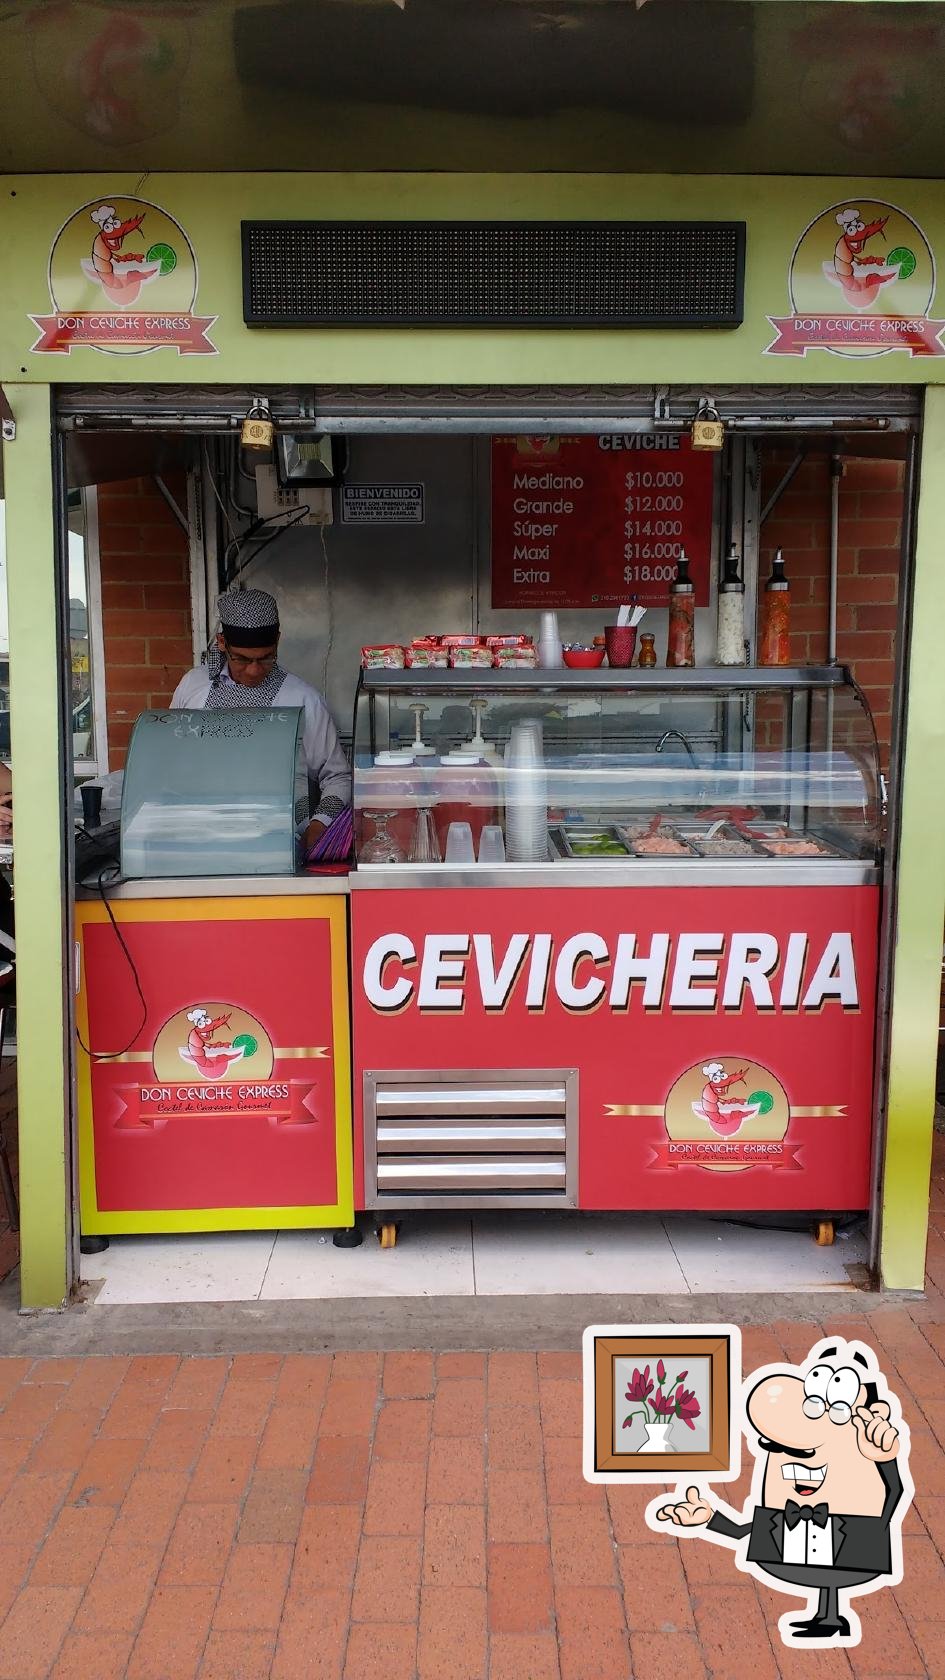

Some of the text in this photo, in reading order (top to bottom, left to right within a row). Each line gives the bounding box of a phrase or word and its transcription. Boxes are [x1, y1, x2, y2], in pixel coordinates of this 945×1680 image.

[57, 317, 191, 330] DON CEVICHE EXPRESS
[794, 320, 925, 333] DON CEVICHE EXPRESS
[598, 434, 680, 450] CEVICHE
[513, 471, 684, 490] Mediano $10.000
[346, 488, 419, 498] BIENVENIDO
[513, 495, 683, 514] Grande $12.000
[513, 520, 683, 540] Súper $14.000
[513, 542, 681, 561] Maxi $16.000
[513, 568, 551, 583] Extra
[362, 932, 861, 1015] CEVICHERIA
[141, 1084, 289, 1102] DON CEVICHE EXPRESS
[185, 1103, 194, 1111] de
[237, 1100, 272, 1110] Gourmet
[669, 1144, 783, 1154] DON CEVICHE EXPRESS
